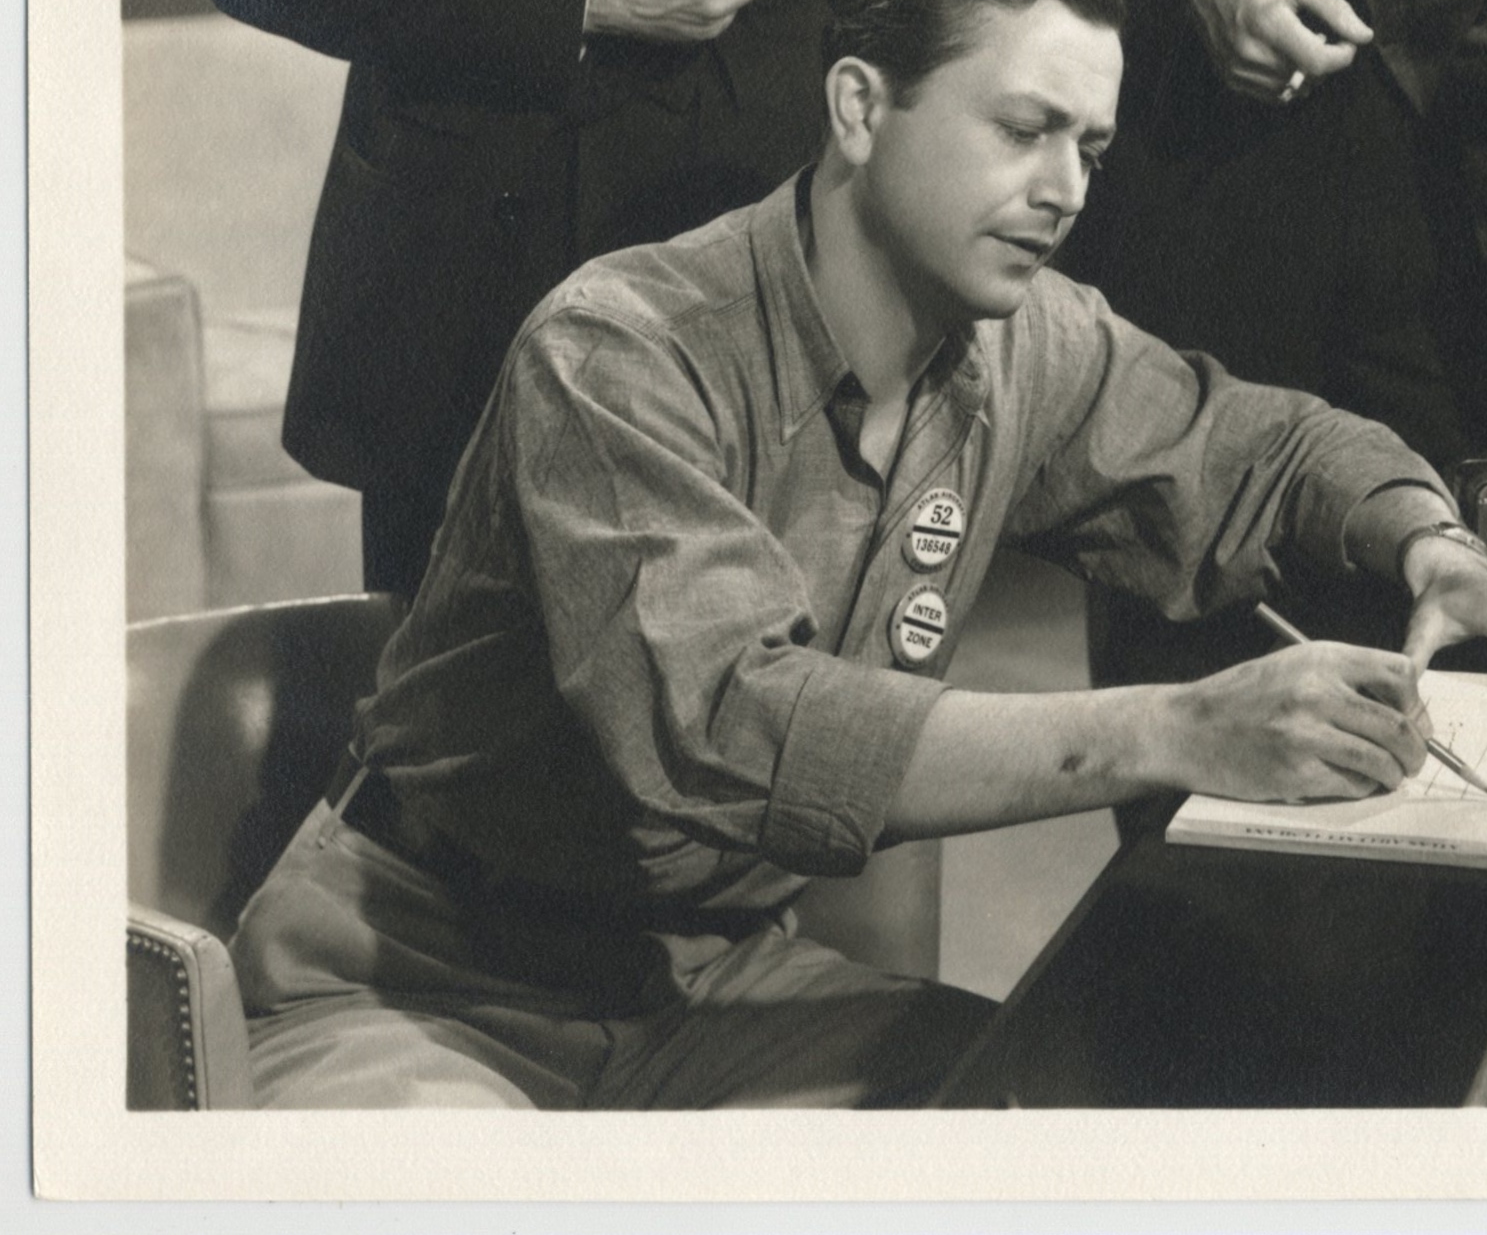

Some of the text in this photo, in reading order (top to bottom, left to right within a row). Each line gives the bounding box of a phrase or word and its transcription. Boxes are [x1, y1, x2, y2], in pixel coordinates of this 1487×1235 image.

[930, 504, 954, 526] 52
[913, 603, 942, 622] INTER
[906, 630, 933, 649] ZONE
